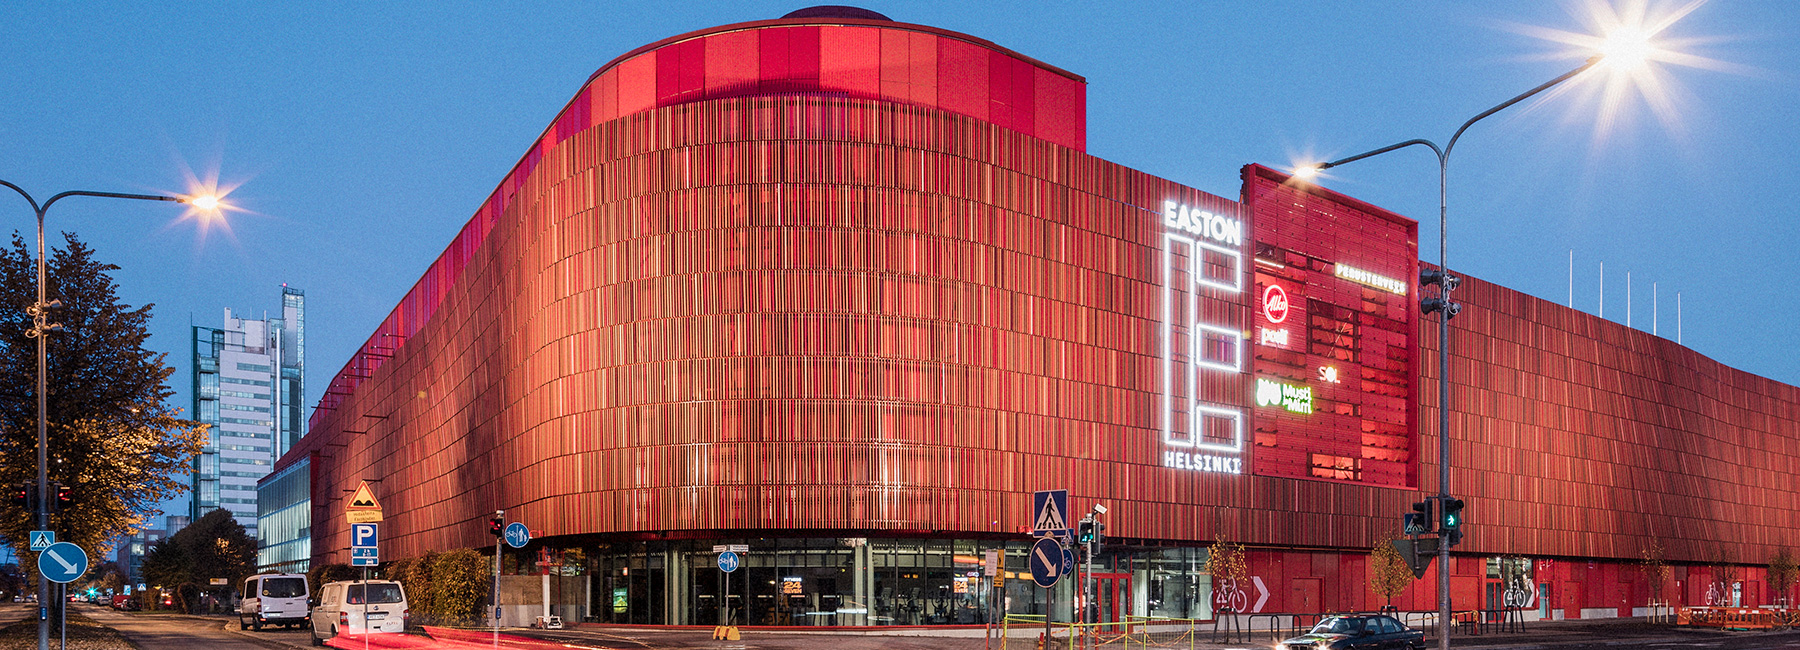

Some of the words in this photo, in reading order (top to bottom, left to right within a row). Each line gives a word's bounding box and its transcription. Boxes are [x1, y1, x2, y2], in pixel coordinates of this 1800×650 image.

[1164, 200, 1241, 247] EASTON
[1266, 295, 1286, 311] Alko
[1319, 366, 1341, 384] SOL
[1283, 384, 1311, 400] Musti
[1164, 451, 1241, 474] HELSINKI
[357, 526, 374, 545] P
[783, 581, 802, 589] 24
